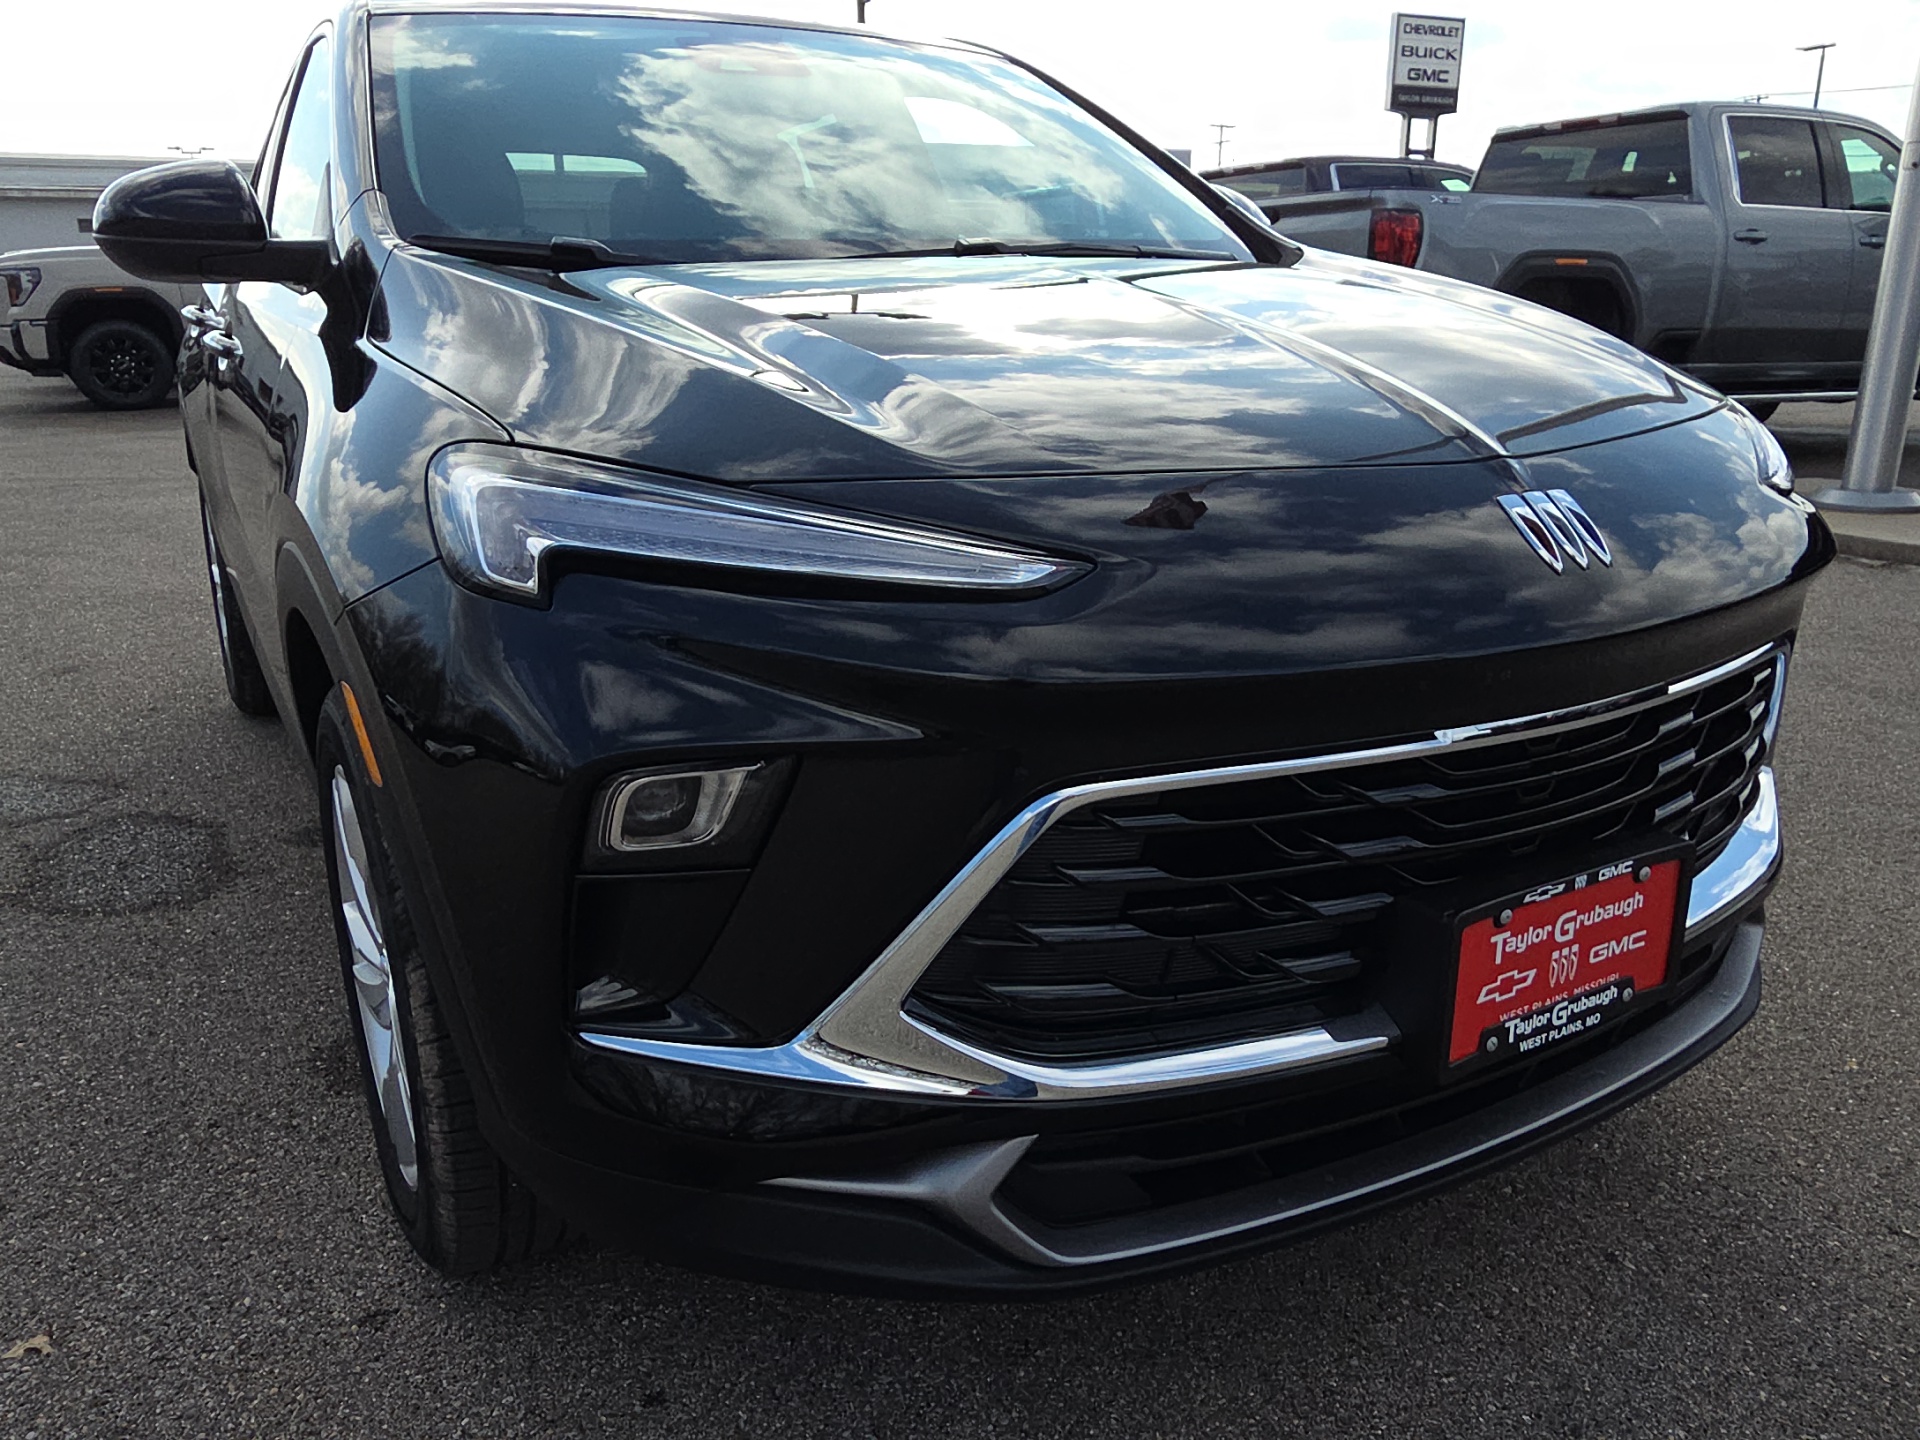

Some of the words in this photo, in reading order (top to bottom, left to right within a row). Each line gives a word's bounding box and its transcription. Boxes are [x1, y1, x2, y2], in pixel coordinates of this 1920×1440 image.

[1403, 23, 1460, 37] CHEVROLET
[1401, 45, 1458, 61] BUICK
[1407, 68, 1449, 82] GMC
[1598, 861, 1633, 881] GMC
[1490, 926, 1553, 965] Taylor
[1554, 892, 1644, 943] Grubaugh
[1589, 930, 1647, 964] GMC
[1504, 1012, 1550, 1043] Taylor
[1551, 985, 1619, 1026] Grubaugh
[1519, 1032, 1548, 1053] WEST
[1548, 1019, 1585, 1042] PLAINS,
[1585, 1012, 1601, 1028] MO
